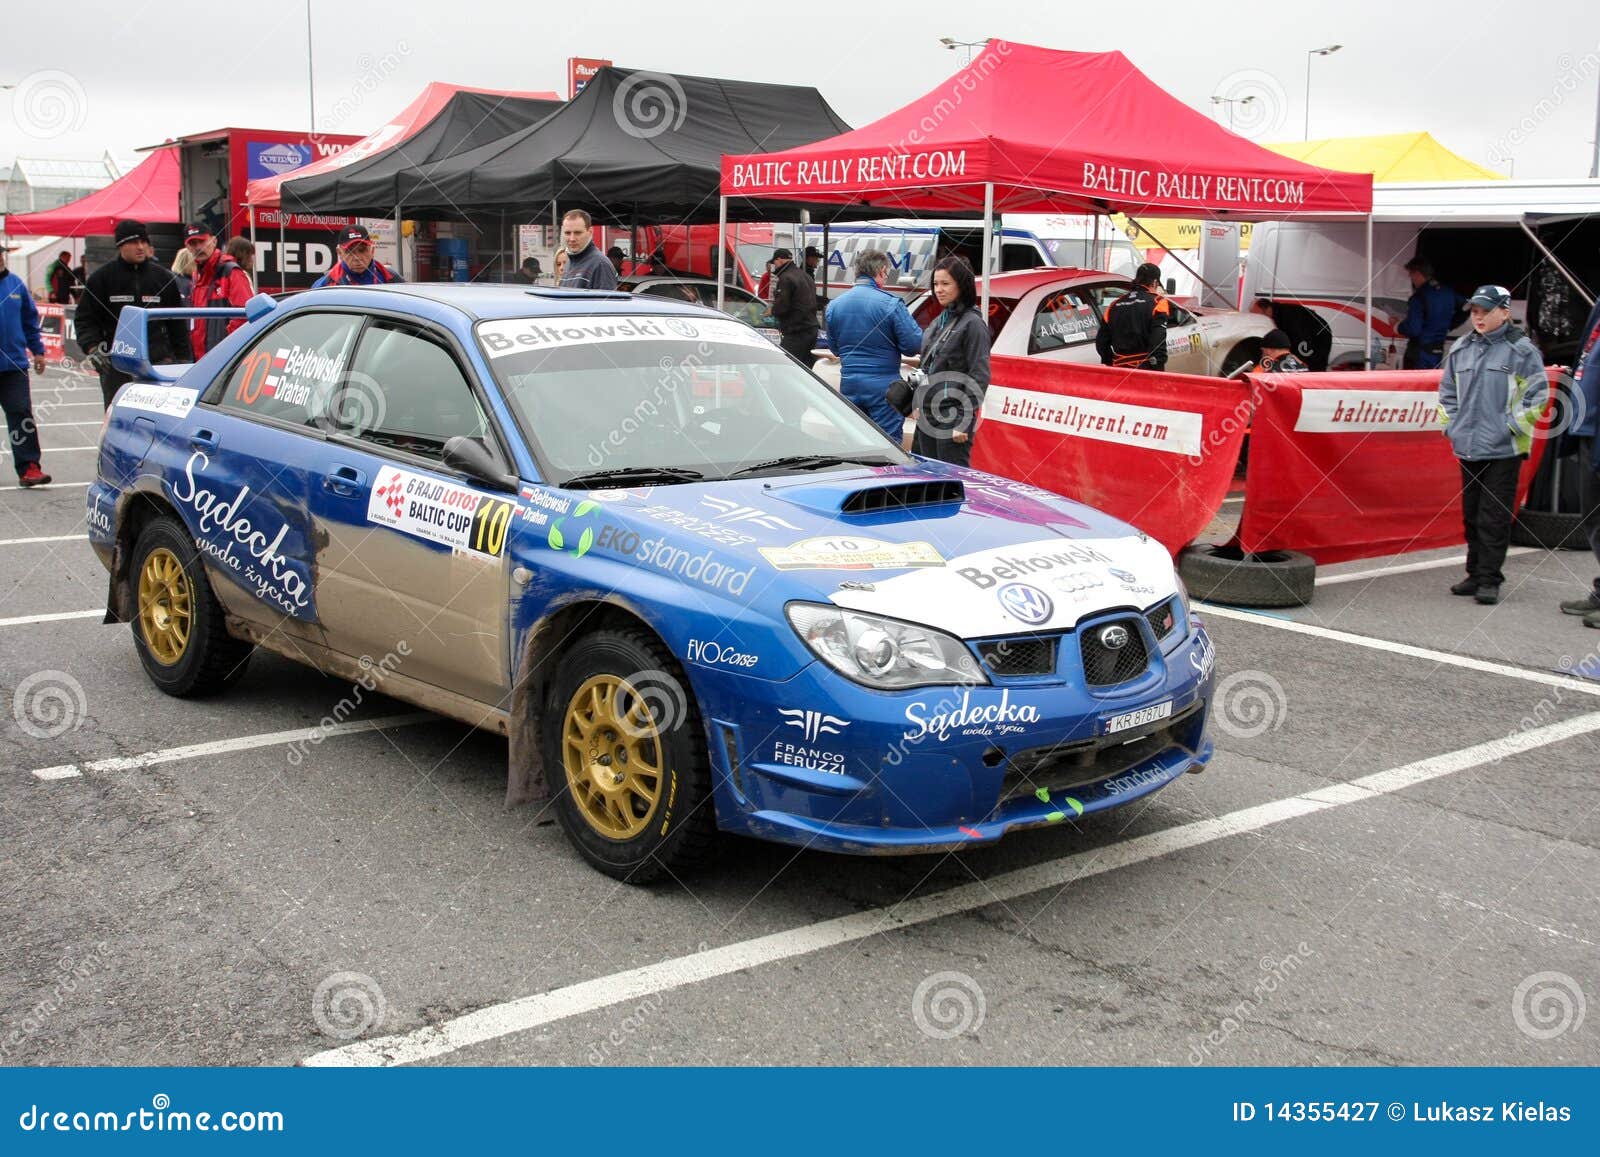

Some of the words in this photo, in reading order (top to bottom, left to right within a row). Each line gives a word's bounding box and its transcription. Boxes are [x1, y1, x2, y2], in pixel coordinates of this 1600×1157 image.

[733, 160, 792, 188] BALTIC
[798, 157, 853, 186] RALLY
[857, 150, 966, 182] RENT.COM
[1082, 162, 1150, 196] BALTIC
[1156, 172, 1211, 200] RALLY
[1216, 176, 1305, 204] RENT.COM
[236, 350, 272, 406] 10
[273, 375, 311, 407] Drahan
[1001, 396, 1169, 441] balticrallyrent.com
[406, 478, 414, 494] 6
[414, 480, 444, 504] RAJD
[442, 488, 479, 512] LOTOS
[173, 451, 308, 607] Sądecka
[409, 501, 445, 527] BALTIC
[447, 511, 471, 534] CUP
[476, 498, 511, 556] 10
[522, 507, 548, 525] Drahan
[196, 537, 242, 571] woda
[903, 688, 1040, 742] Sądecka
[962, 723, 993, 736] woda
[1116, 714, 1132, 730] KR
[774, 752, 845, 776] FERUZZI
[775, 741, 845, 763] FRANCO
[1104, 759, 1169, 796] standard
